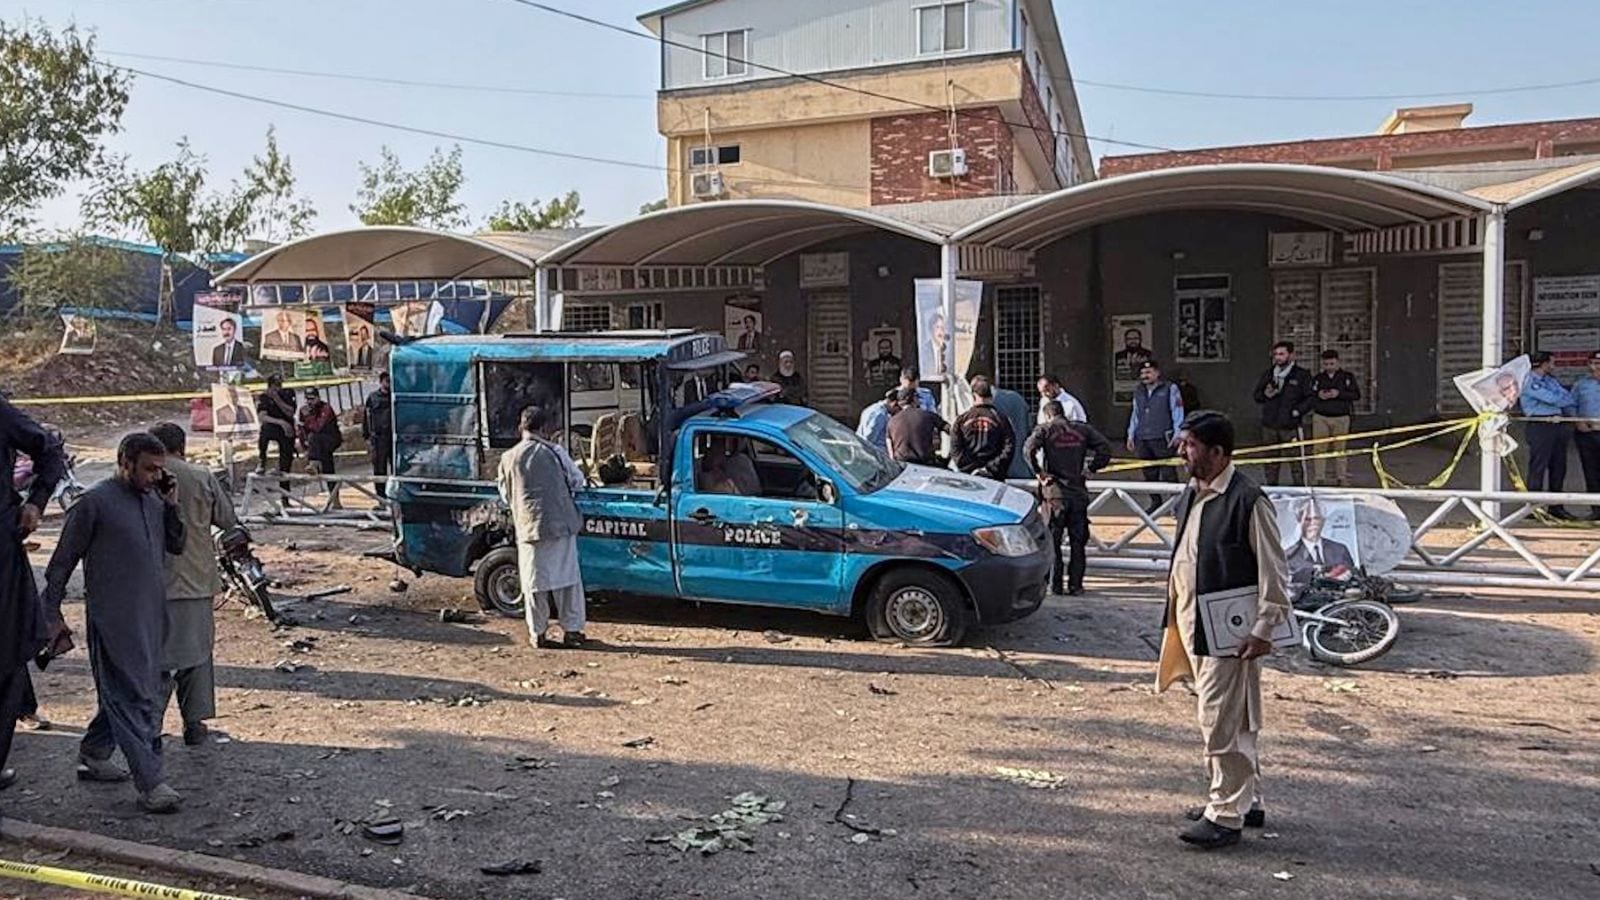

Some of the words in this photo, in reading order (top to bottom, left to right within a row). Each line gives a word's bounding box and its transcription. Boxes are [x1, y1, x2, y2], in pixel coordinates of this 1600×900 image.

[692, 337, 710, 358] POLICE
[585, 518, 647, 536] CAPITAL
[724, 527, 781, 544] POLICE
